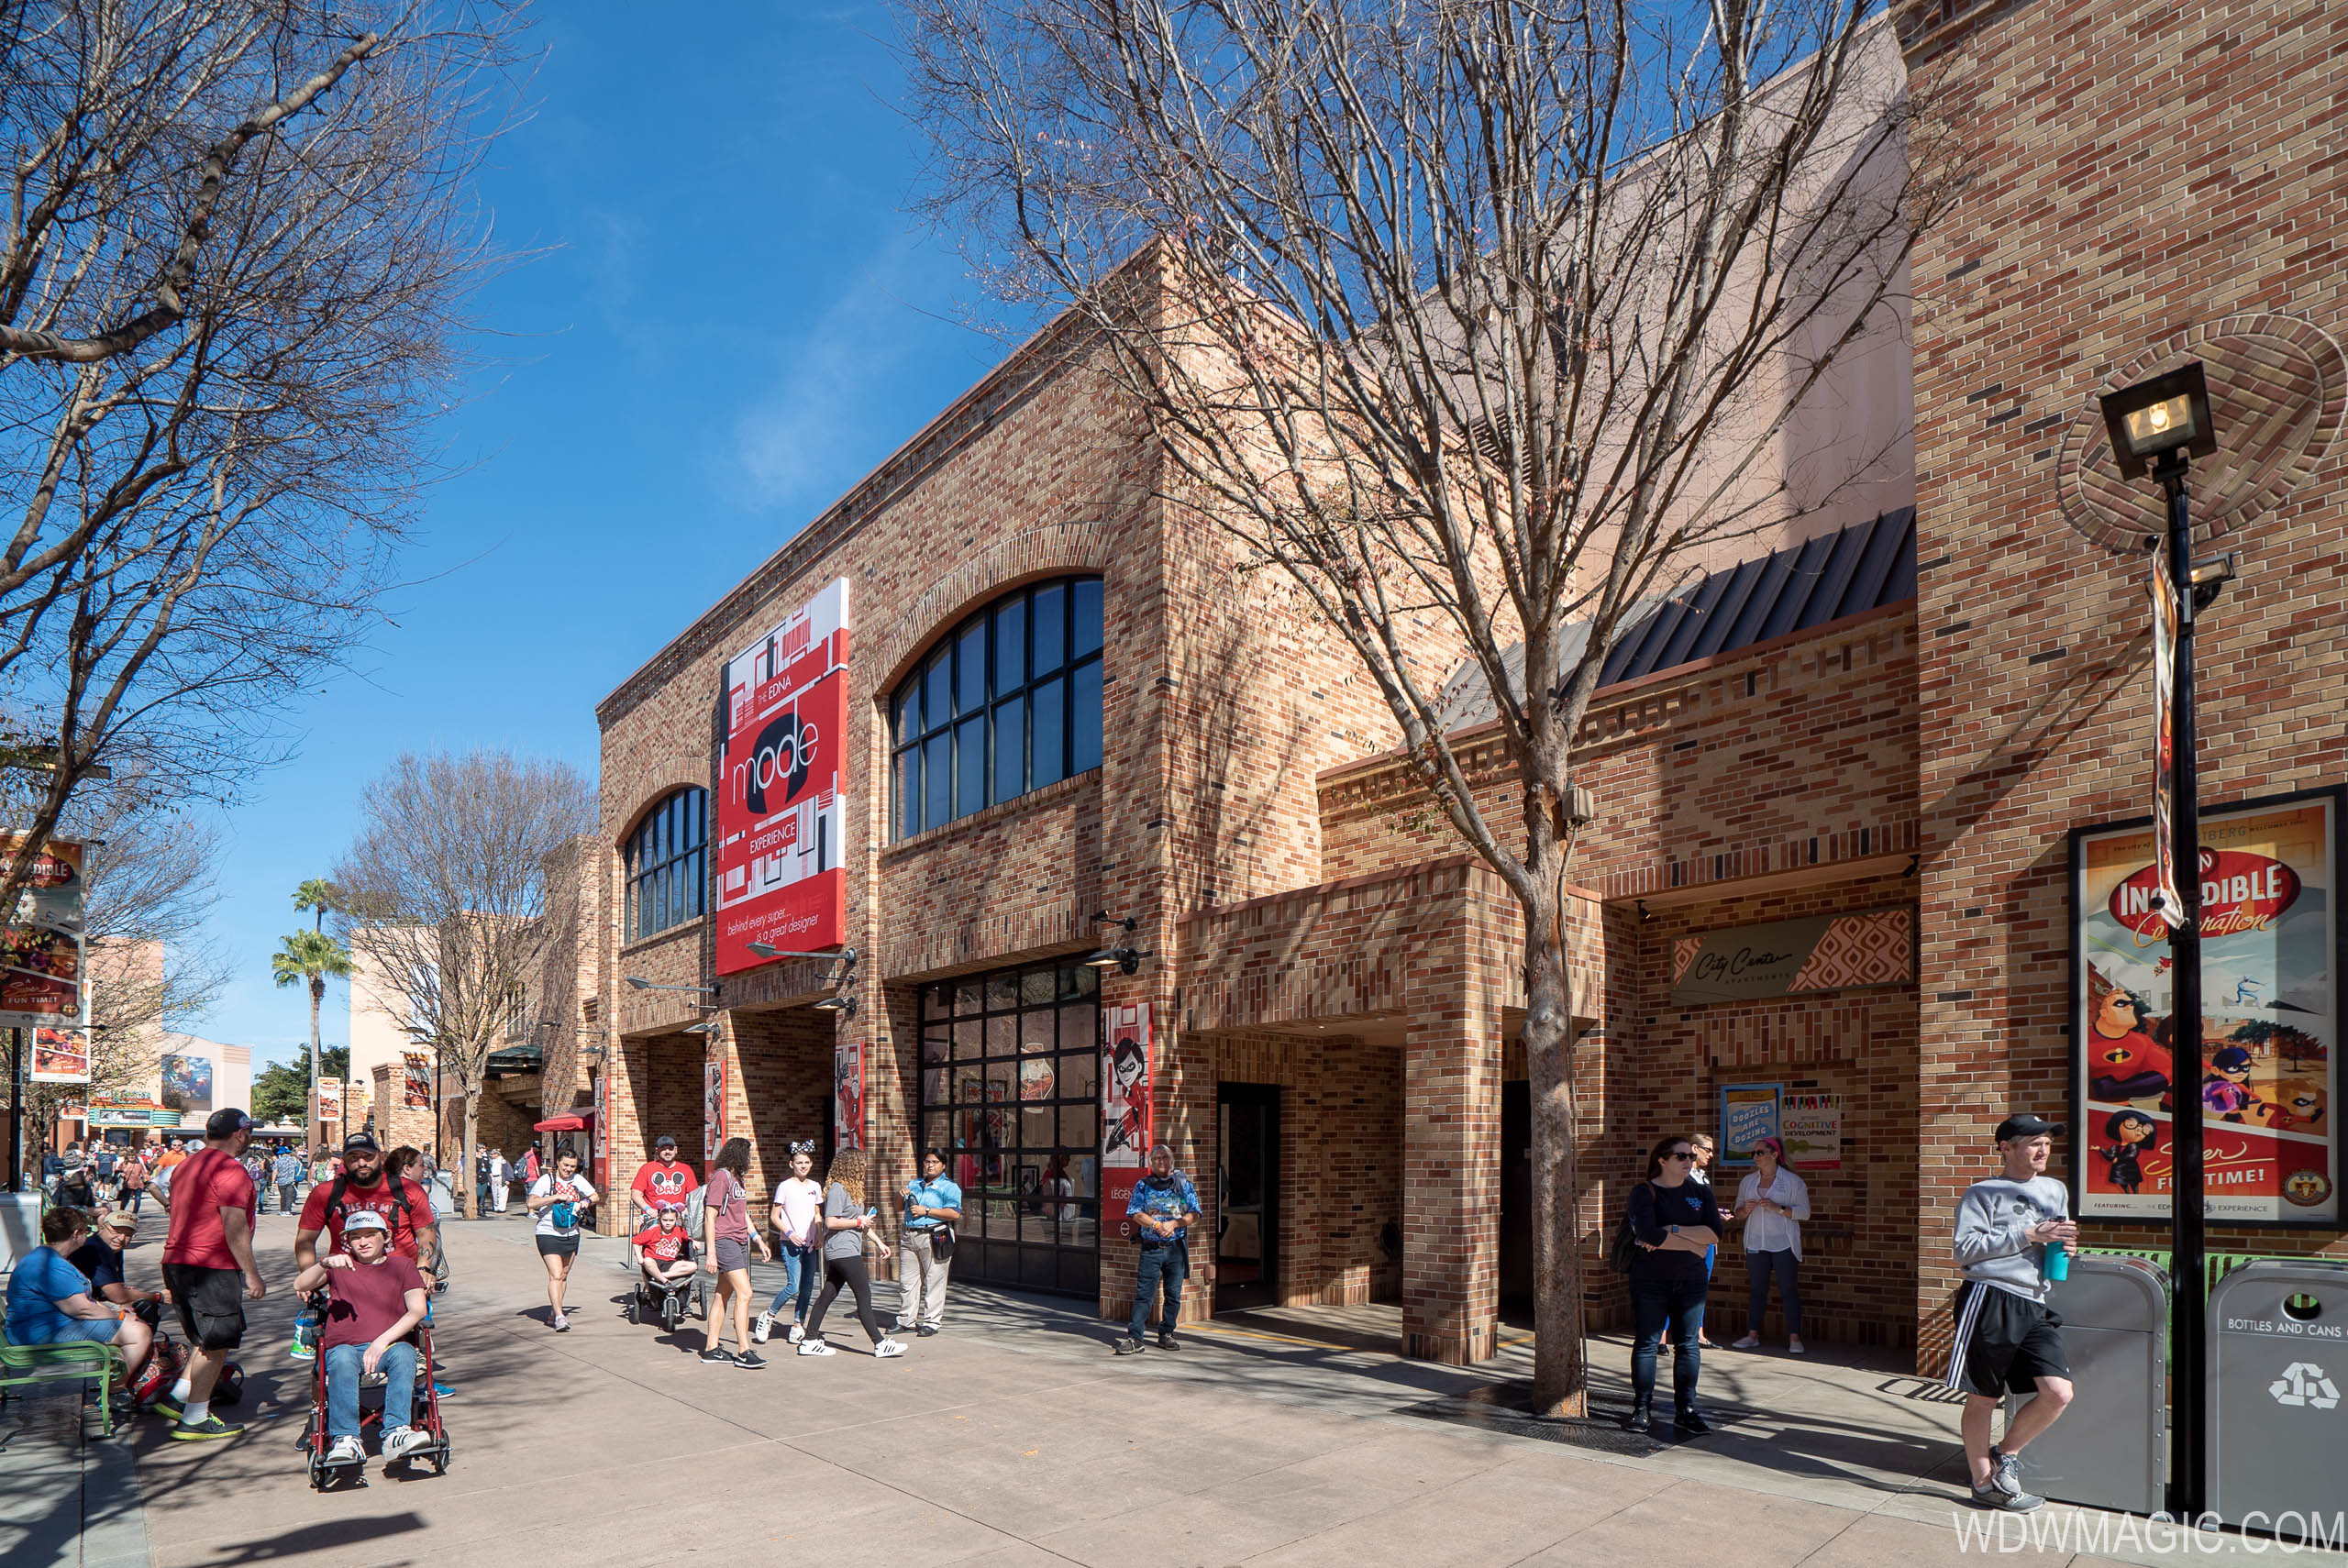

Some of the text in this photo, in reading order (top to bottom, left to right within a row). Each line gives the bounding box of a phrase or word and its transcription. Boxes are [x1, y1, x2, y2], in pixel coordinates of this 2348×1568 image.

[758, 675, 792, 704] THE EDNA
[733, 695, 819, 805] mode
[749, 821, 796, 855] EXPERIENCE
[2120, 863, 2284, 917] INDIBLE
[727, 915, 749, 936] behind
[749, 913, 767, 929] every
[757, 914, 819, 944] is a great designer
[1695, 953, 1729, 982] City
[1733, 1106, 1769, 1123] DOOZLES
[1743, 1120, 1760, 1132] ARE
[1783, 1120, 1837, 1130] COGNITIVE
[1735, 1127, 1767, 1143] DOZING
[2203, 1168, 2265, 1187] TIME!
[657, 1185, 681, 1195] DAD
[365, 1201, 376, 1210] IS
[2218, 1204, 2268, 1213] EXPERIENCE
[1120, 1221, 1130, 1236] e
[2228, 1318, 2272, 1332] BOTTLES
[2276, 1322, 2303, 1334] AND
[2308, 1324, 2342, 1338] CANS
